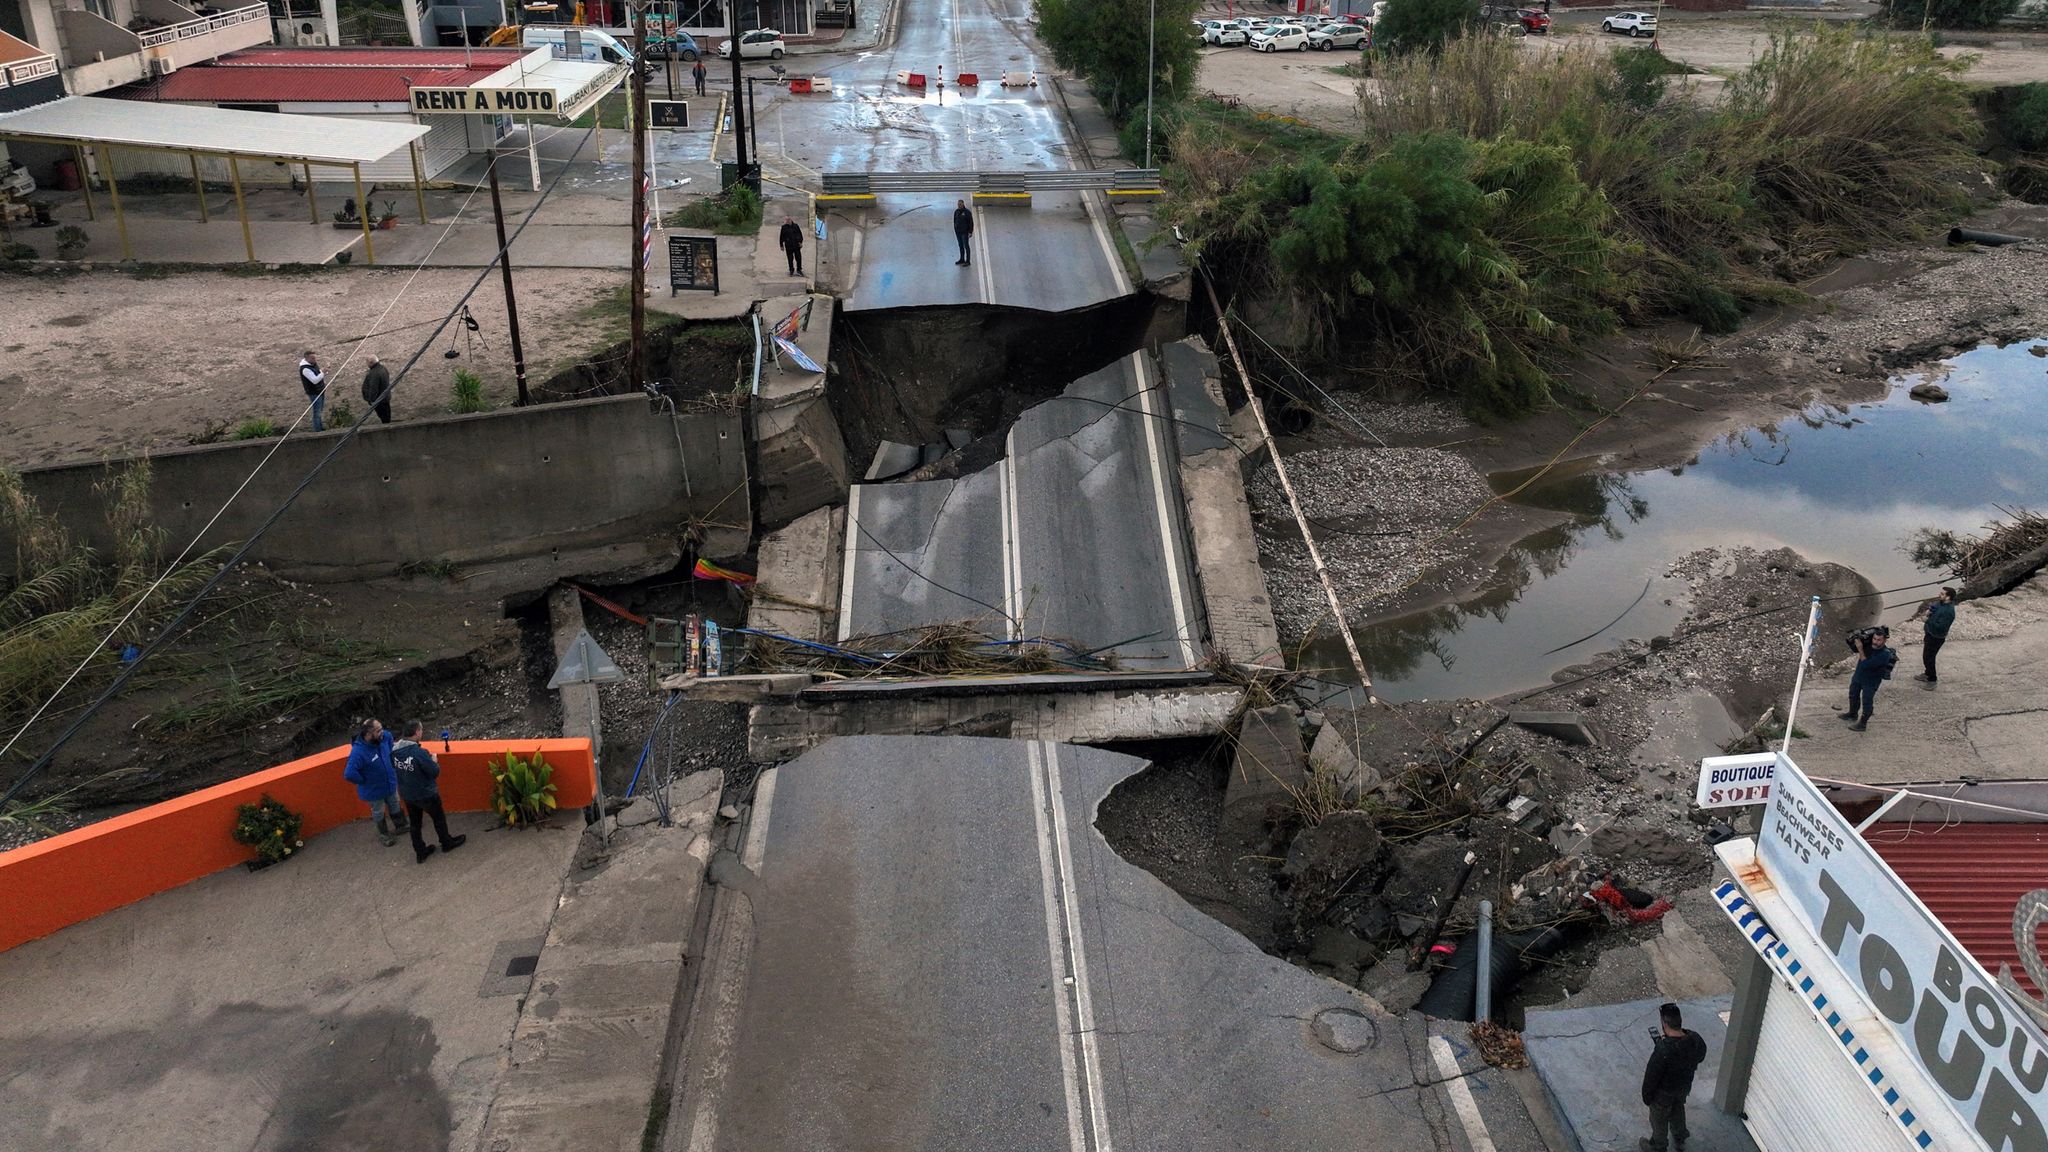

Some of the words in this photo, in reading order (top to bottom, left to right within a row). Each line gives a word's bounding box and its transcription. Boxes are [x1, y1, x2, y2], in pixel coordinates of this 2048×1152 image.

[590, 74, 607, 91] MOTO
[415, 91, 467, 110] RENT
[475, 91, 489, 110] A
[496, 91, 553, 110] MOTO
[1711, 765, 1775, 784] BOUTIQUE
[1776, 800, 1831, 860] BEACHWEAR
[1776, 820, 1811, 864] HATS
